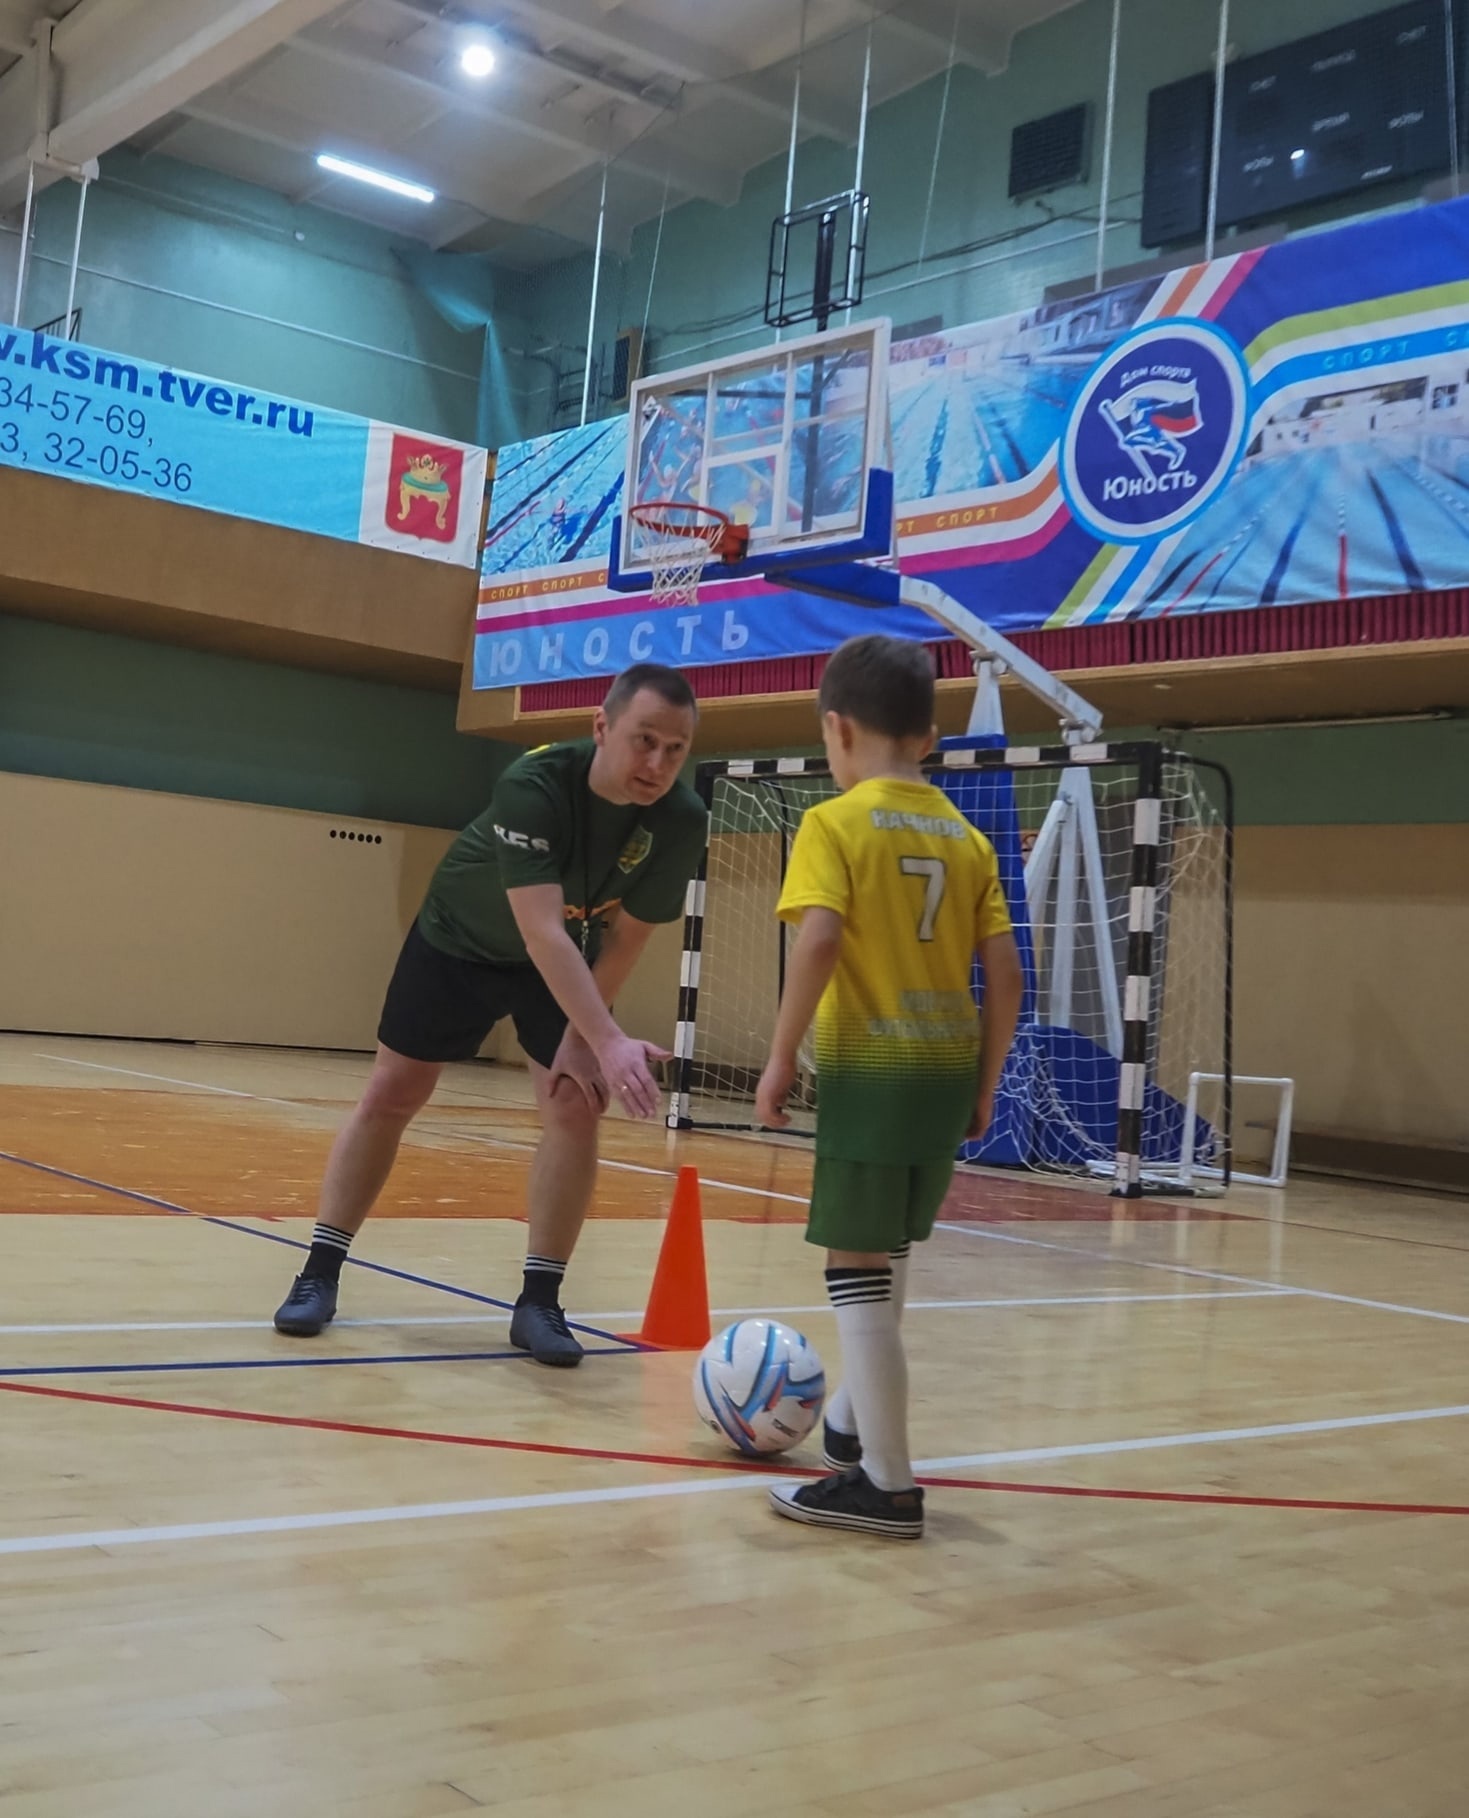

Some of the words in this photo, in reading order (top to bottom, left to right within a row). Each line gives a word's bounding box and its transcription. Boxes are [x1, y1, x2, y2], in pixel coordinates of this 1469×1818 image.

[1322, 340, 1409, 370] СПОРТ
[43, 432, 193, 492] 32-05-36
[935, 506, 999, 529] СПОРТ
[542, 575, 584, 592] СПОРТ
[489, 609, 750, 678] ЮНОСТЬ
[899, 856, 947, 943] 7
